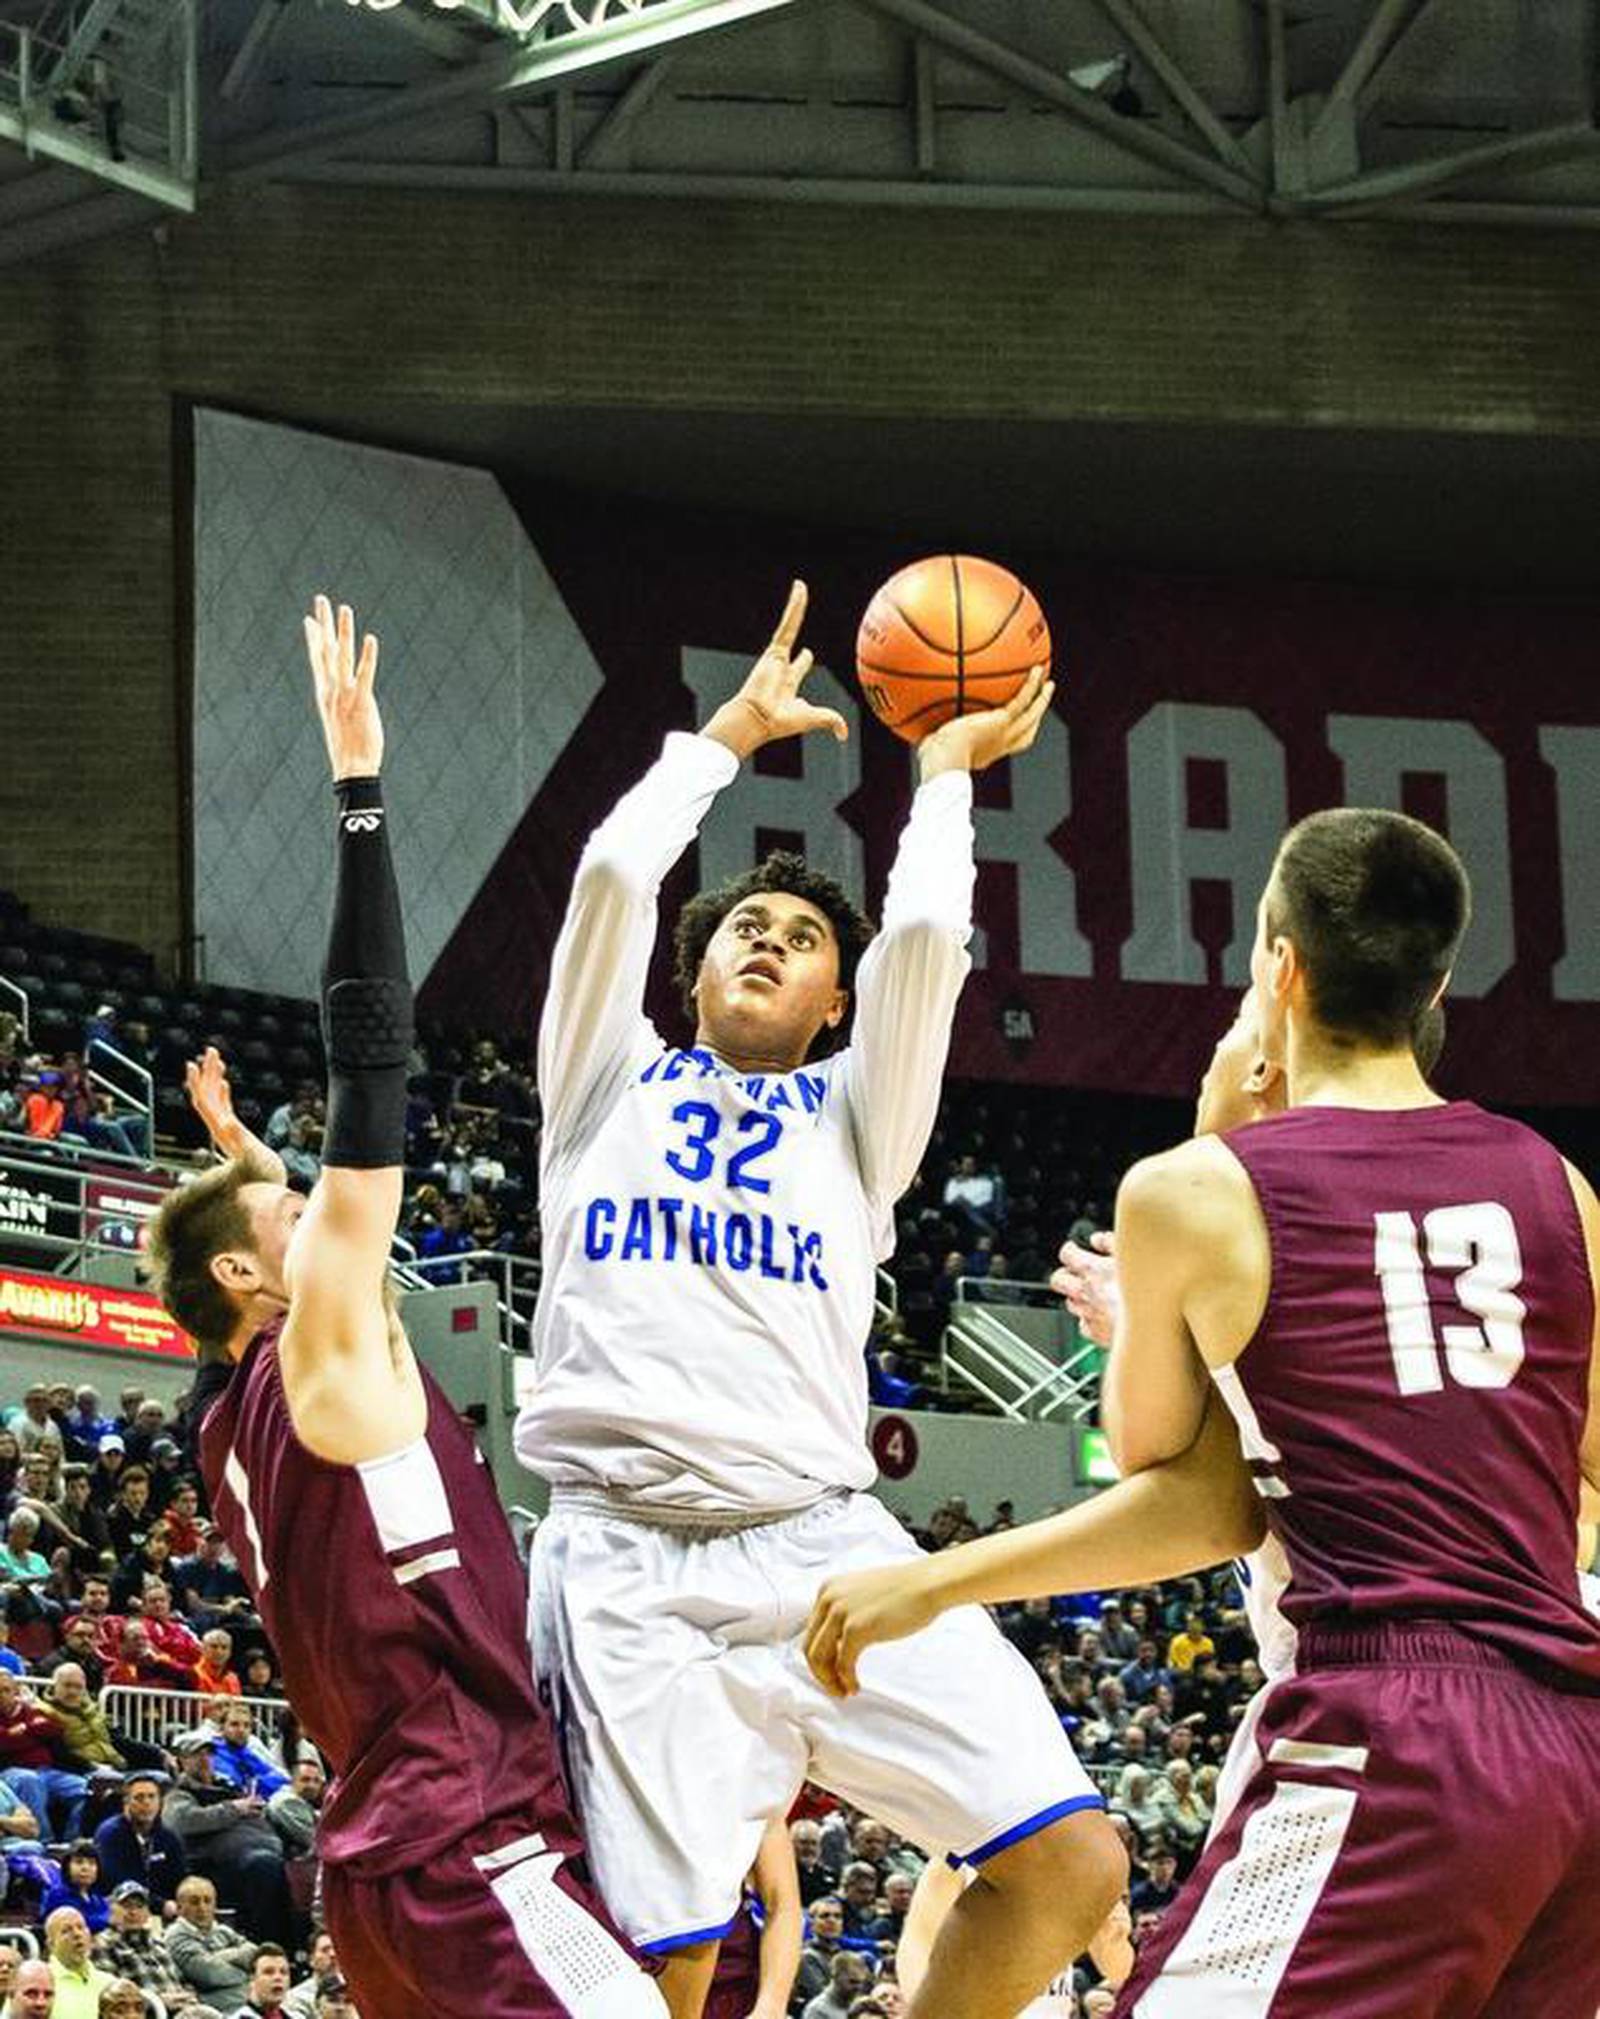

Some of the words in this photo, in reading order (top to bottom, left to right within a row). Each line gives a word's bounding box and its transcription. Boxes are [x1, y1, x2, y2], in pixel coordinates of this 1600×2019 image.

[664, 1100, 784, 1195] 32
[584, 1196, 829, 1292] CATHOLIC
[1373, 1201, 1528, 1397] 13
[886, 1430, 905, 1464] 4
